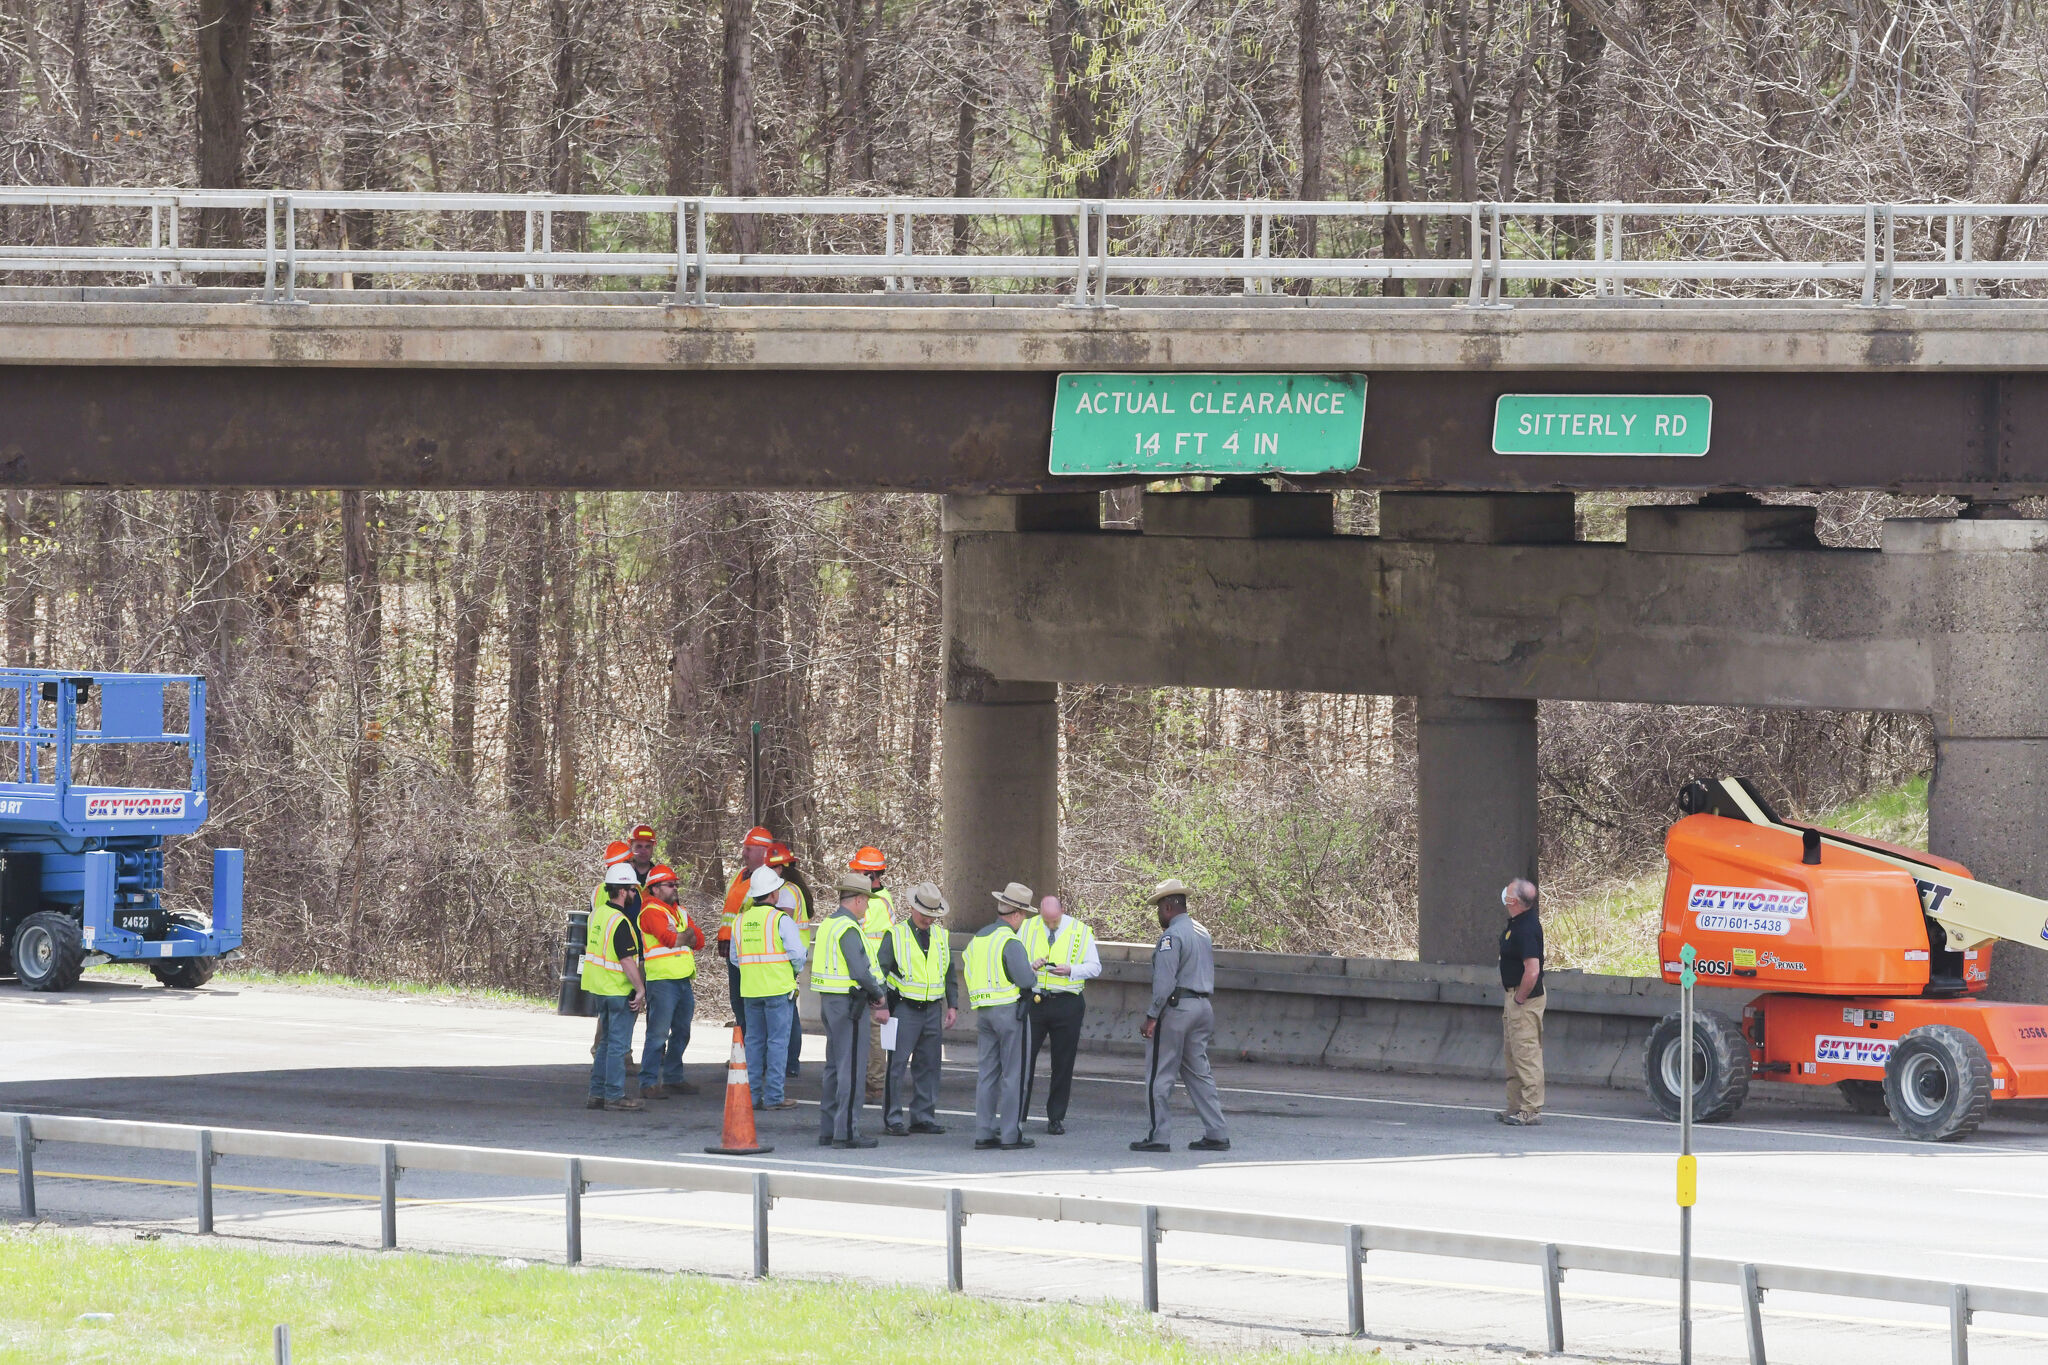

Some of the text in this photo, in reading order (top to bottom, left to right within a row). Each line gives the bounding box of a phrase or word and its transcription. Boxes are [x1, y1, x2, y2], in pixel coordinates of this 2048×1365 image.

[1075, 391, 1346, 415] ACTUAL CLEARANCE
[1517, 413, 1688, 437] SITTERLY RD
[1135, 432, 1279, 455] 14 FT 4 IN
[87, 797, 184, 816] SKYWORKS
[1690, 888, 1807, 915] SKYWORKS
[122, 916, 149, 929] 24623
[2018, 1027, 2048, 1039] 23566
